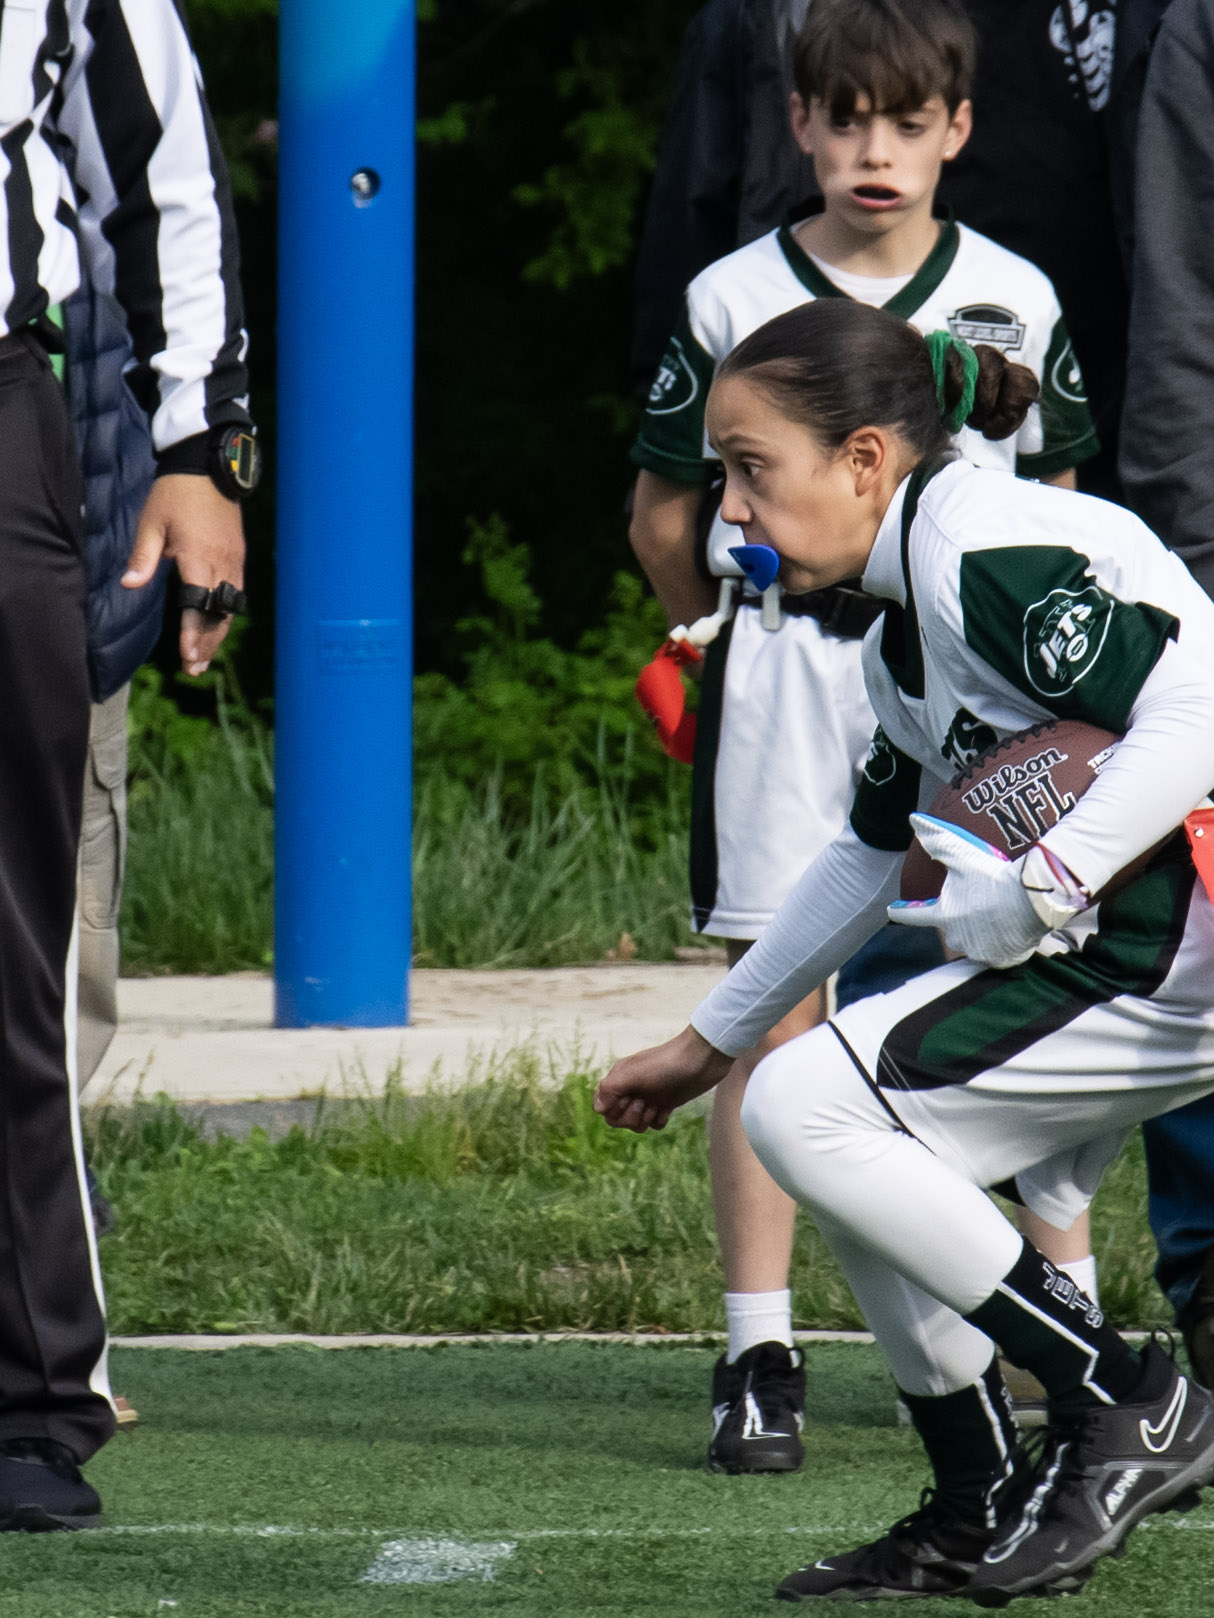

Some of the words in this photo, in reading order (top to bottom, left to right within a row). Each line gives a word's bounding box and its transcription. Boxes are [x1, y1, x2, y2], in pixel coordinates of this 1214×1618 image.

[1039, 602, 1093, 680] JETS
[962, 747, 1069, 814] Wilson
[986, 770, 1077, 850] NFL
